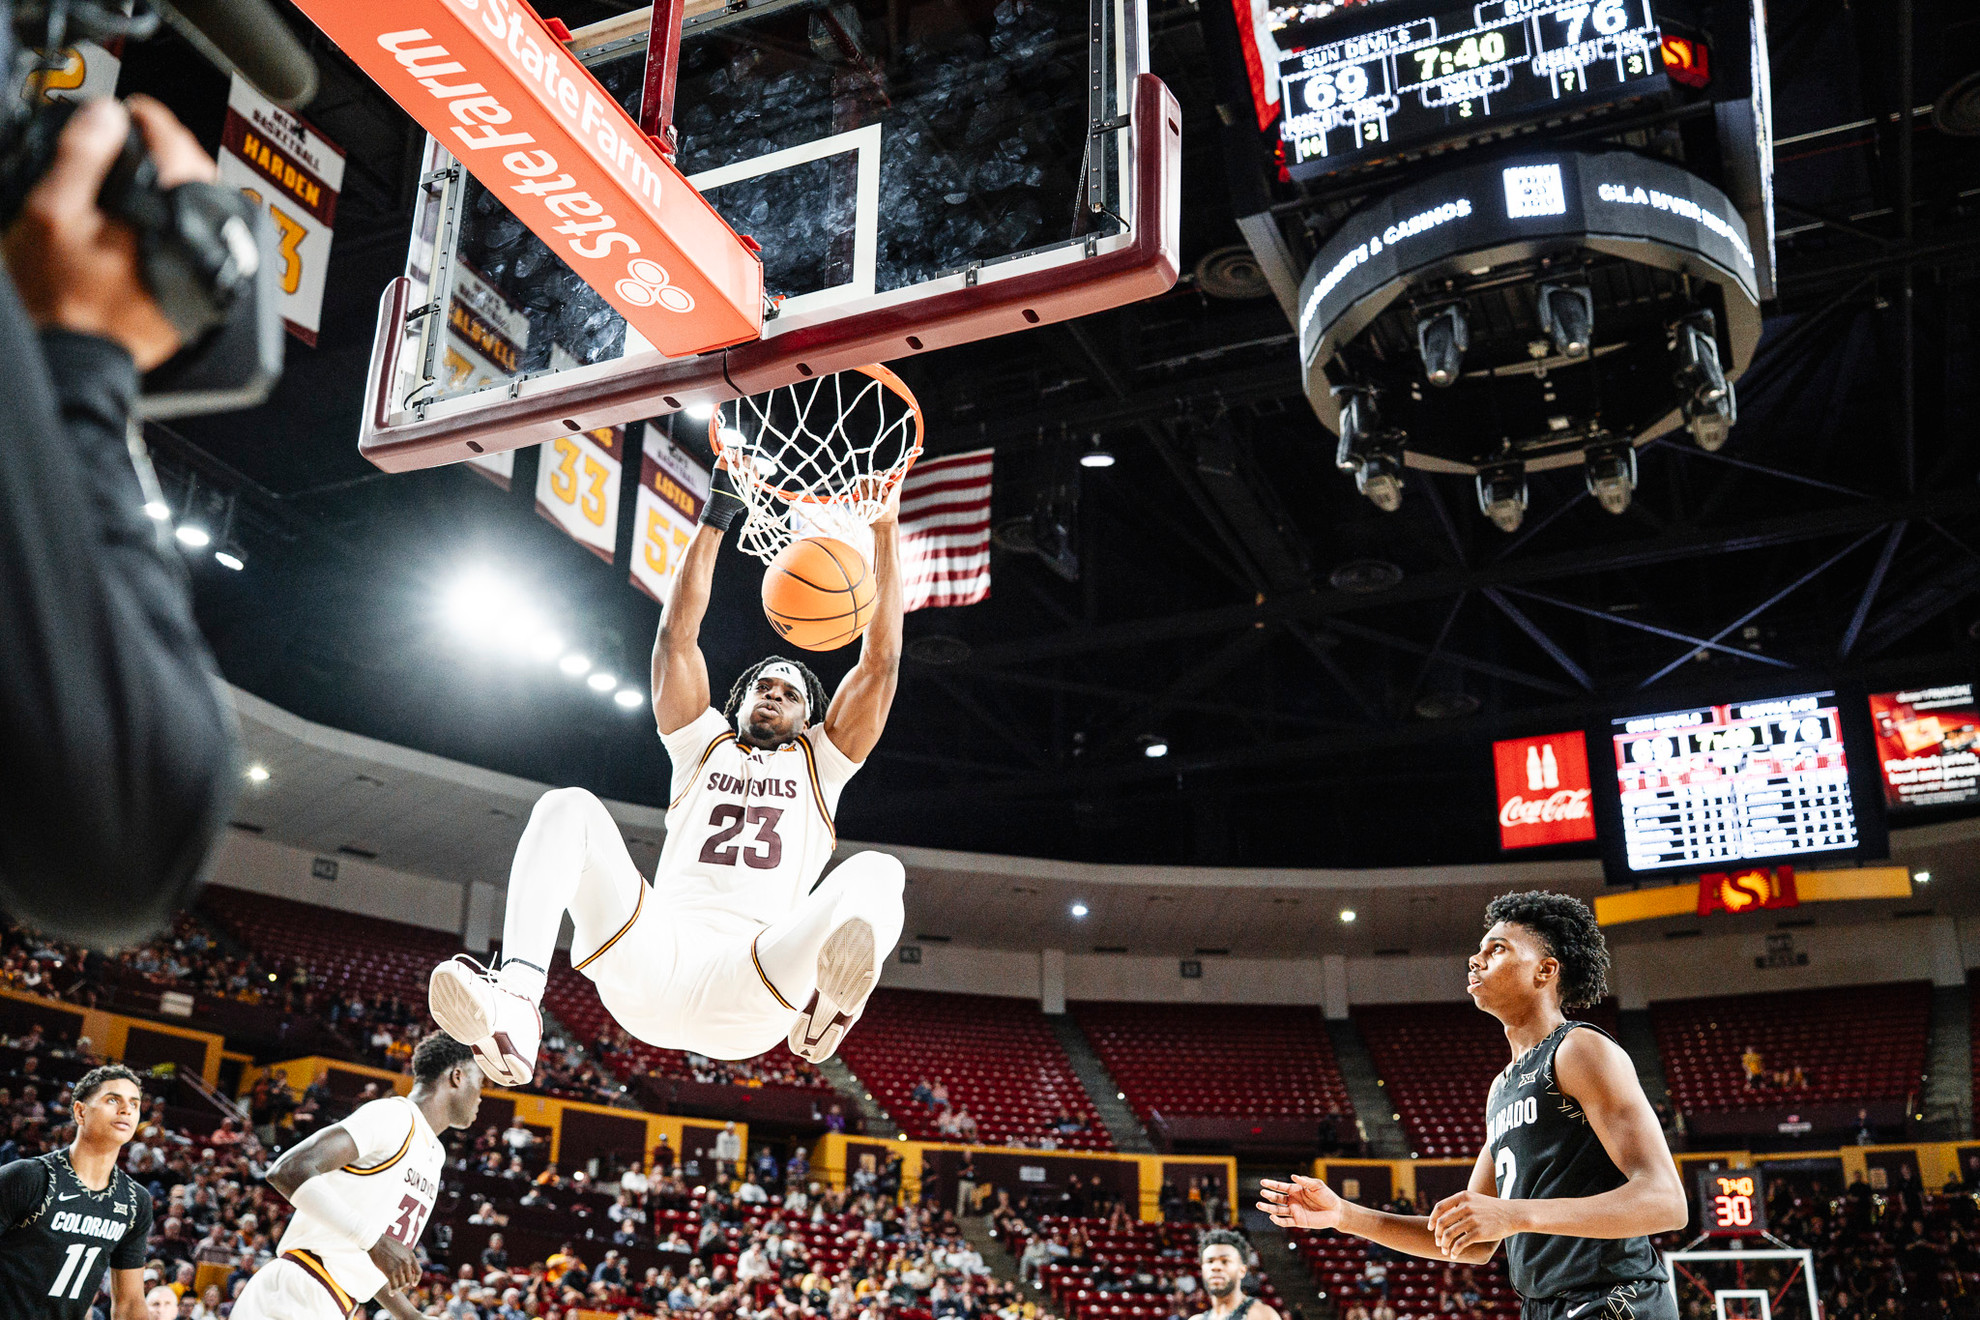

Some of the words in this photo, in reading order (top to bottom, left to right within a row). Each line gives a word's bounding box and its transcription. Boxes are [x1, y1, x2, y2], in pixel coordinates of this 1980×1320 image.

[1555, 0, 1628, 46] 76
[1302, 48, 1341, 70] SUN
[1345, 29, 1411, 59] DEVILS
[1414, 31, 1505, 80] 7:40
[1628, 55, 1643, 74] 3
[1303, 66, 1369, 111] 69
[1561, 71, 1575, 91] 7
[1364, 122, 1379, 141] 3
[242, 133, 321, 208] HARDEN
[550, 437, 607, 527] 33
[706, 772, 745, 795] SUN
[698, 803, 785, 870] 23
[1698, 864, 1800, 917] ASU
[50, 1210, 127, 1242] COLORADO
[1715, 1196, 1753, 1227] 30
[47, 1243, 103, 1300] 11
